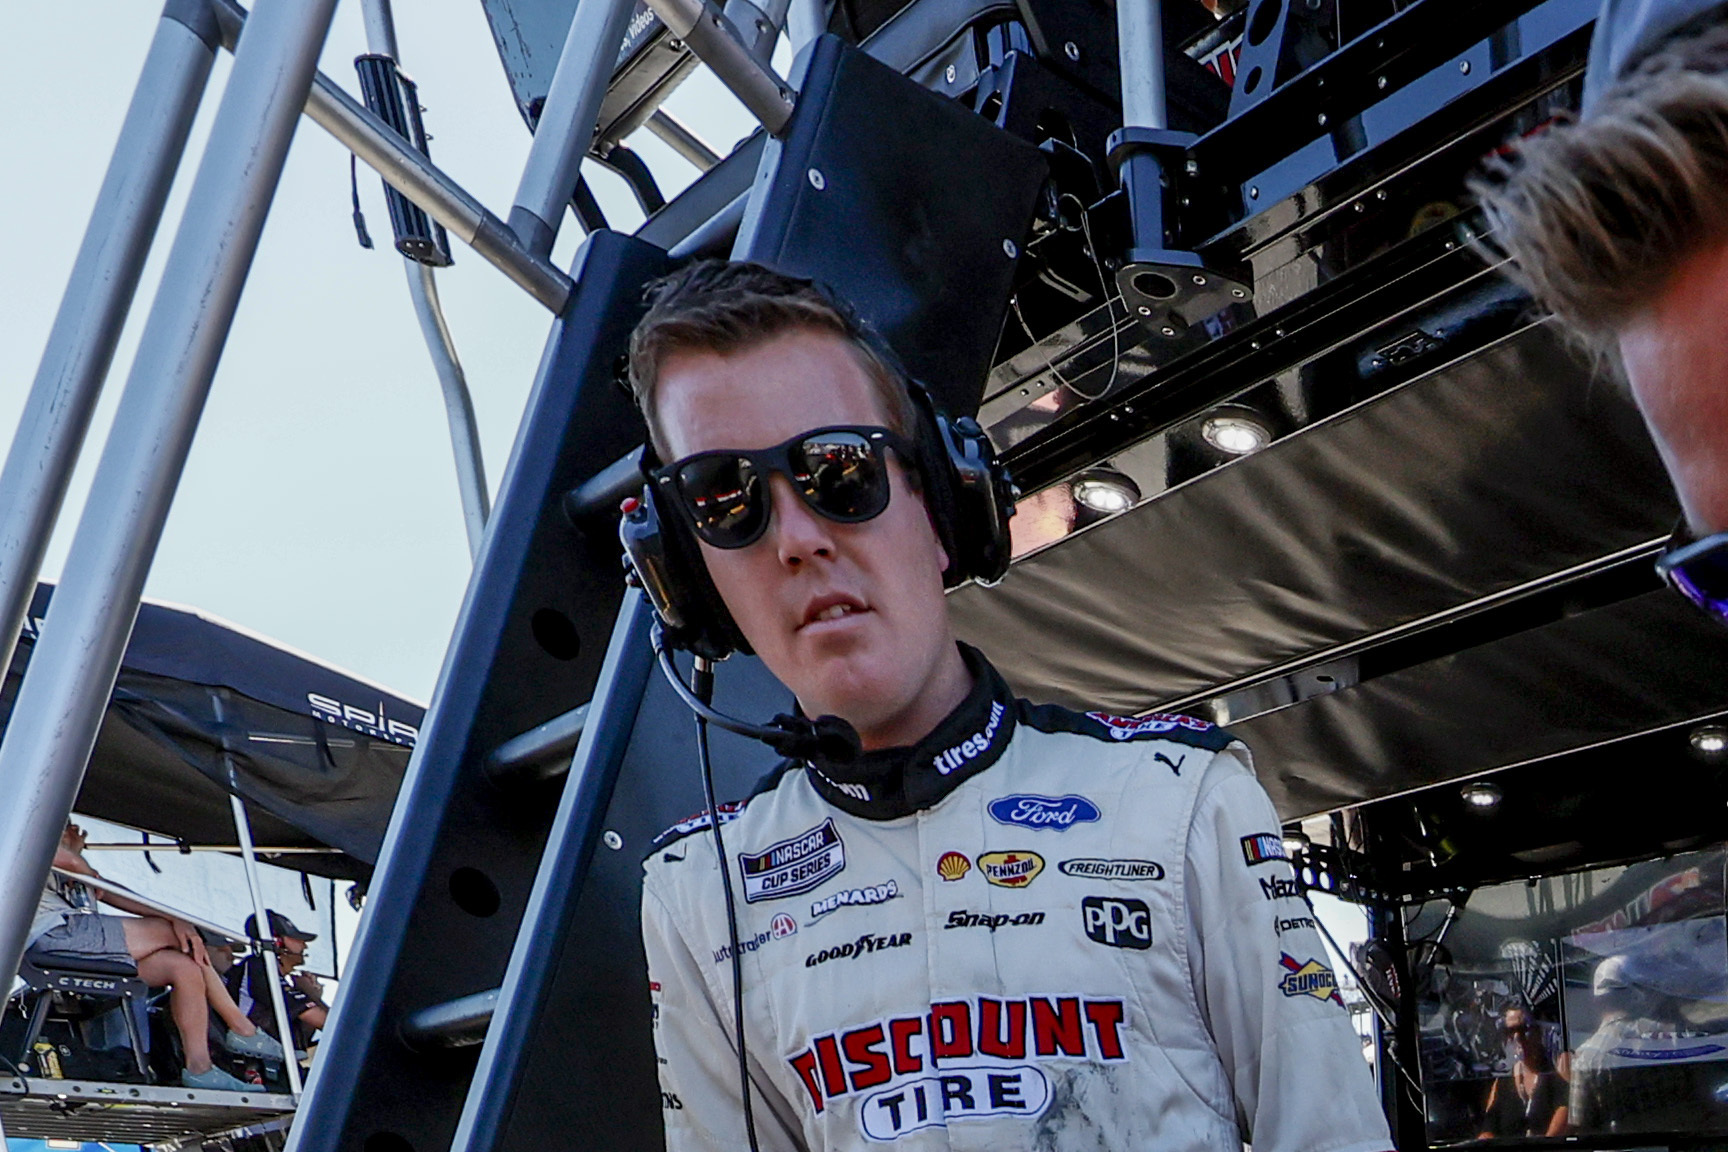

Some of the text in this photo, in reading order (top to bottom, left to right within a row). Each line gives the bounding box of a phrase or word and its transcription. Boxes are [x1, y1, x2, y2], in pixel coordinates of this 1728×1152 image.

[307, 692, 420, 742] SPIR
[311, 709, 416, 748] MOTORSP
[1010, 799, 1075, 825] Ford
[775, 830, 825, 867] NASCAR
[761, 852, 832, 891] CUP SERIES
[1068, 863, 1156, 877] FREIGHTLINER
[811, 879, 900, 918] MENARDS
[943, 910, 1046, 933] Snap-on
[1084, 900, 1149, 944] PPG
[805, 932, 912, 968] GOODYEAR
[73, 978, 116, 989] TECH
[788, 996, 1127, 1115] DISCOUNT
[878, 1073, 1028, 1132] TIRE
